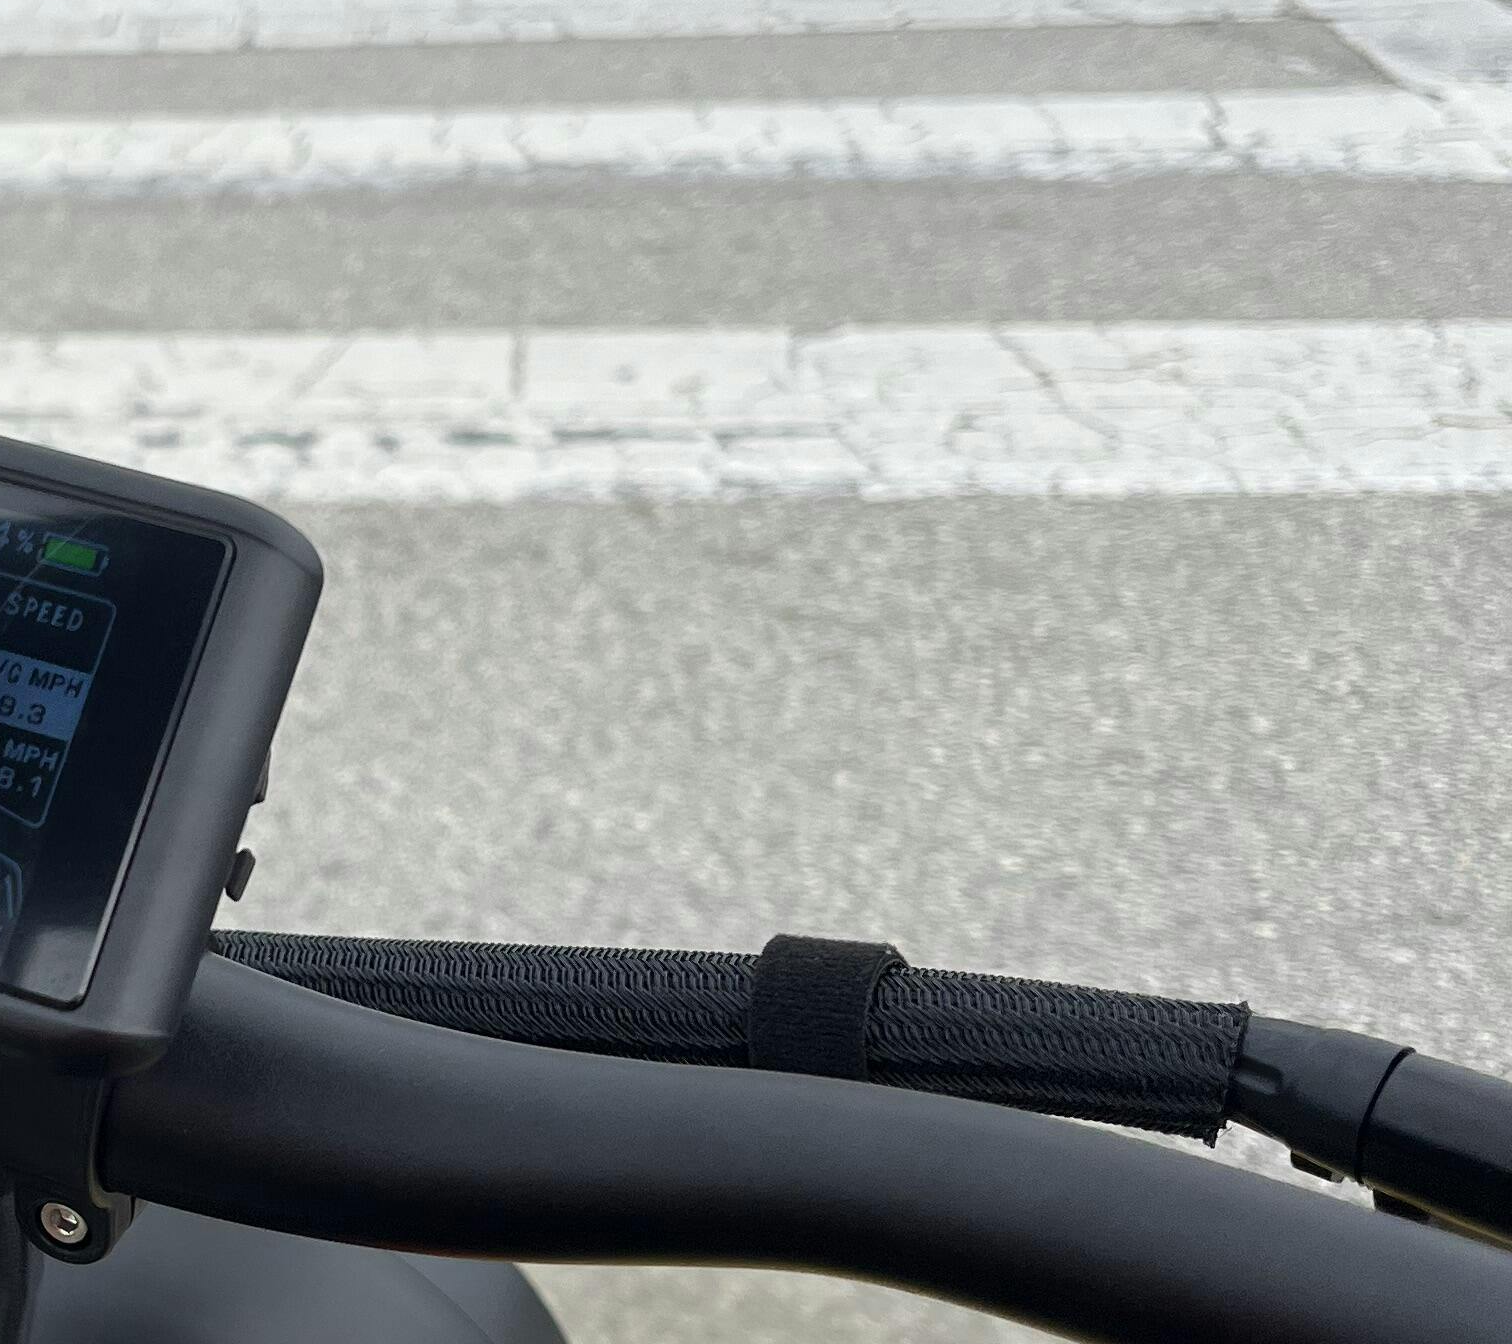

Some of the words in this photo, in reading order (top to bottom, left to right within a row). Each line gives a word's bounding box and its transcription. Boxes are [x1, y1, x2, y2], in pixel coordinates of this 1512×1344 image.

[7, 590, 85, 632] SPEED
[27, 666, 86, 699] MPH
[3, 737, 61, 770] MPH
